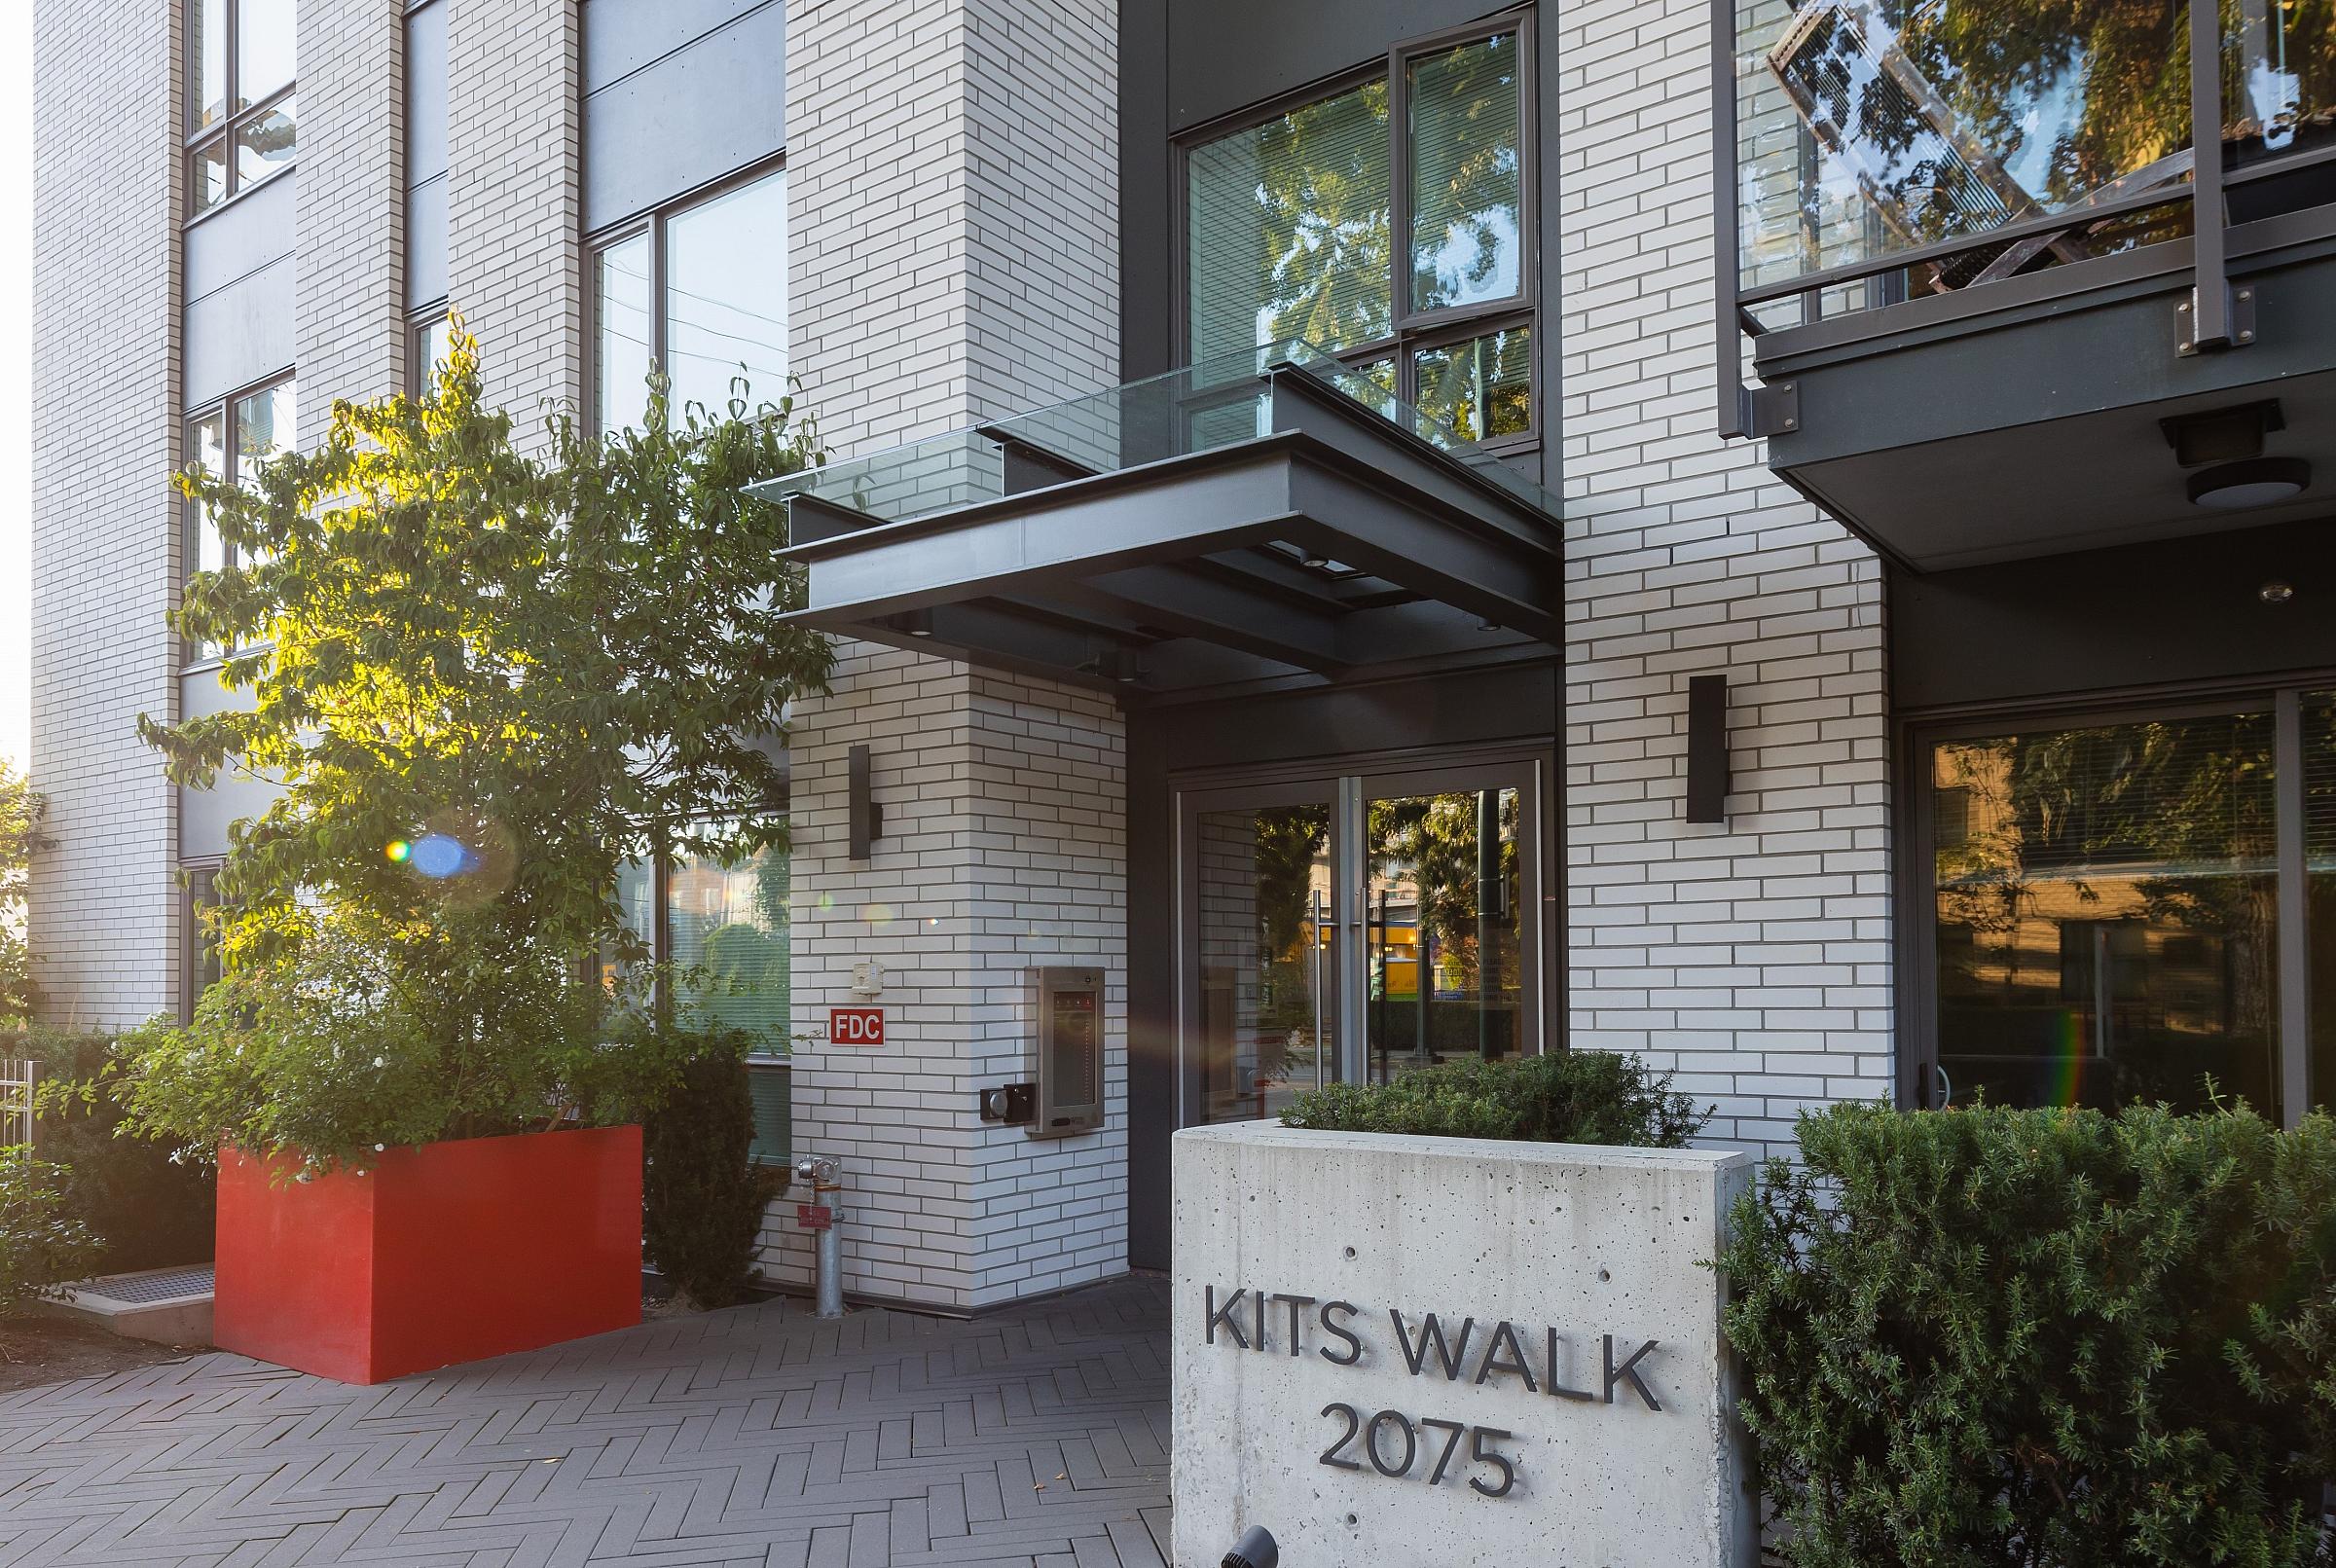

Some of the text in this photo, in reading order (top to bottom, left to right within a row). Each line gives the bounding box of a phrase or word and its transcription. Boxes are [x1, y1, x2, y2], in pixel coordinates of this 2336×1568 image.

[835, 1014, 880, 1039] FDC
[1205, 1285, 1662, 1411] KITS WALK
[1319, 1403, 1515, 1498] 2075
